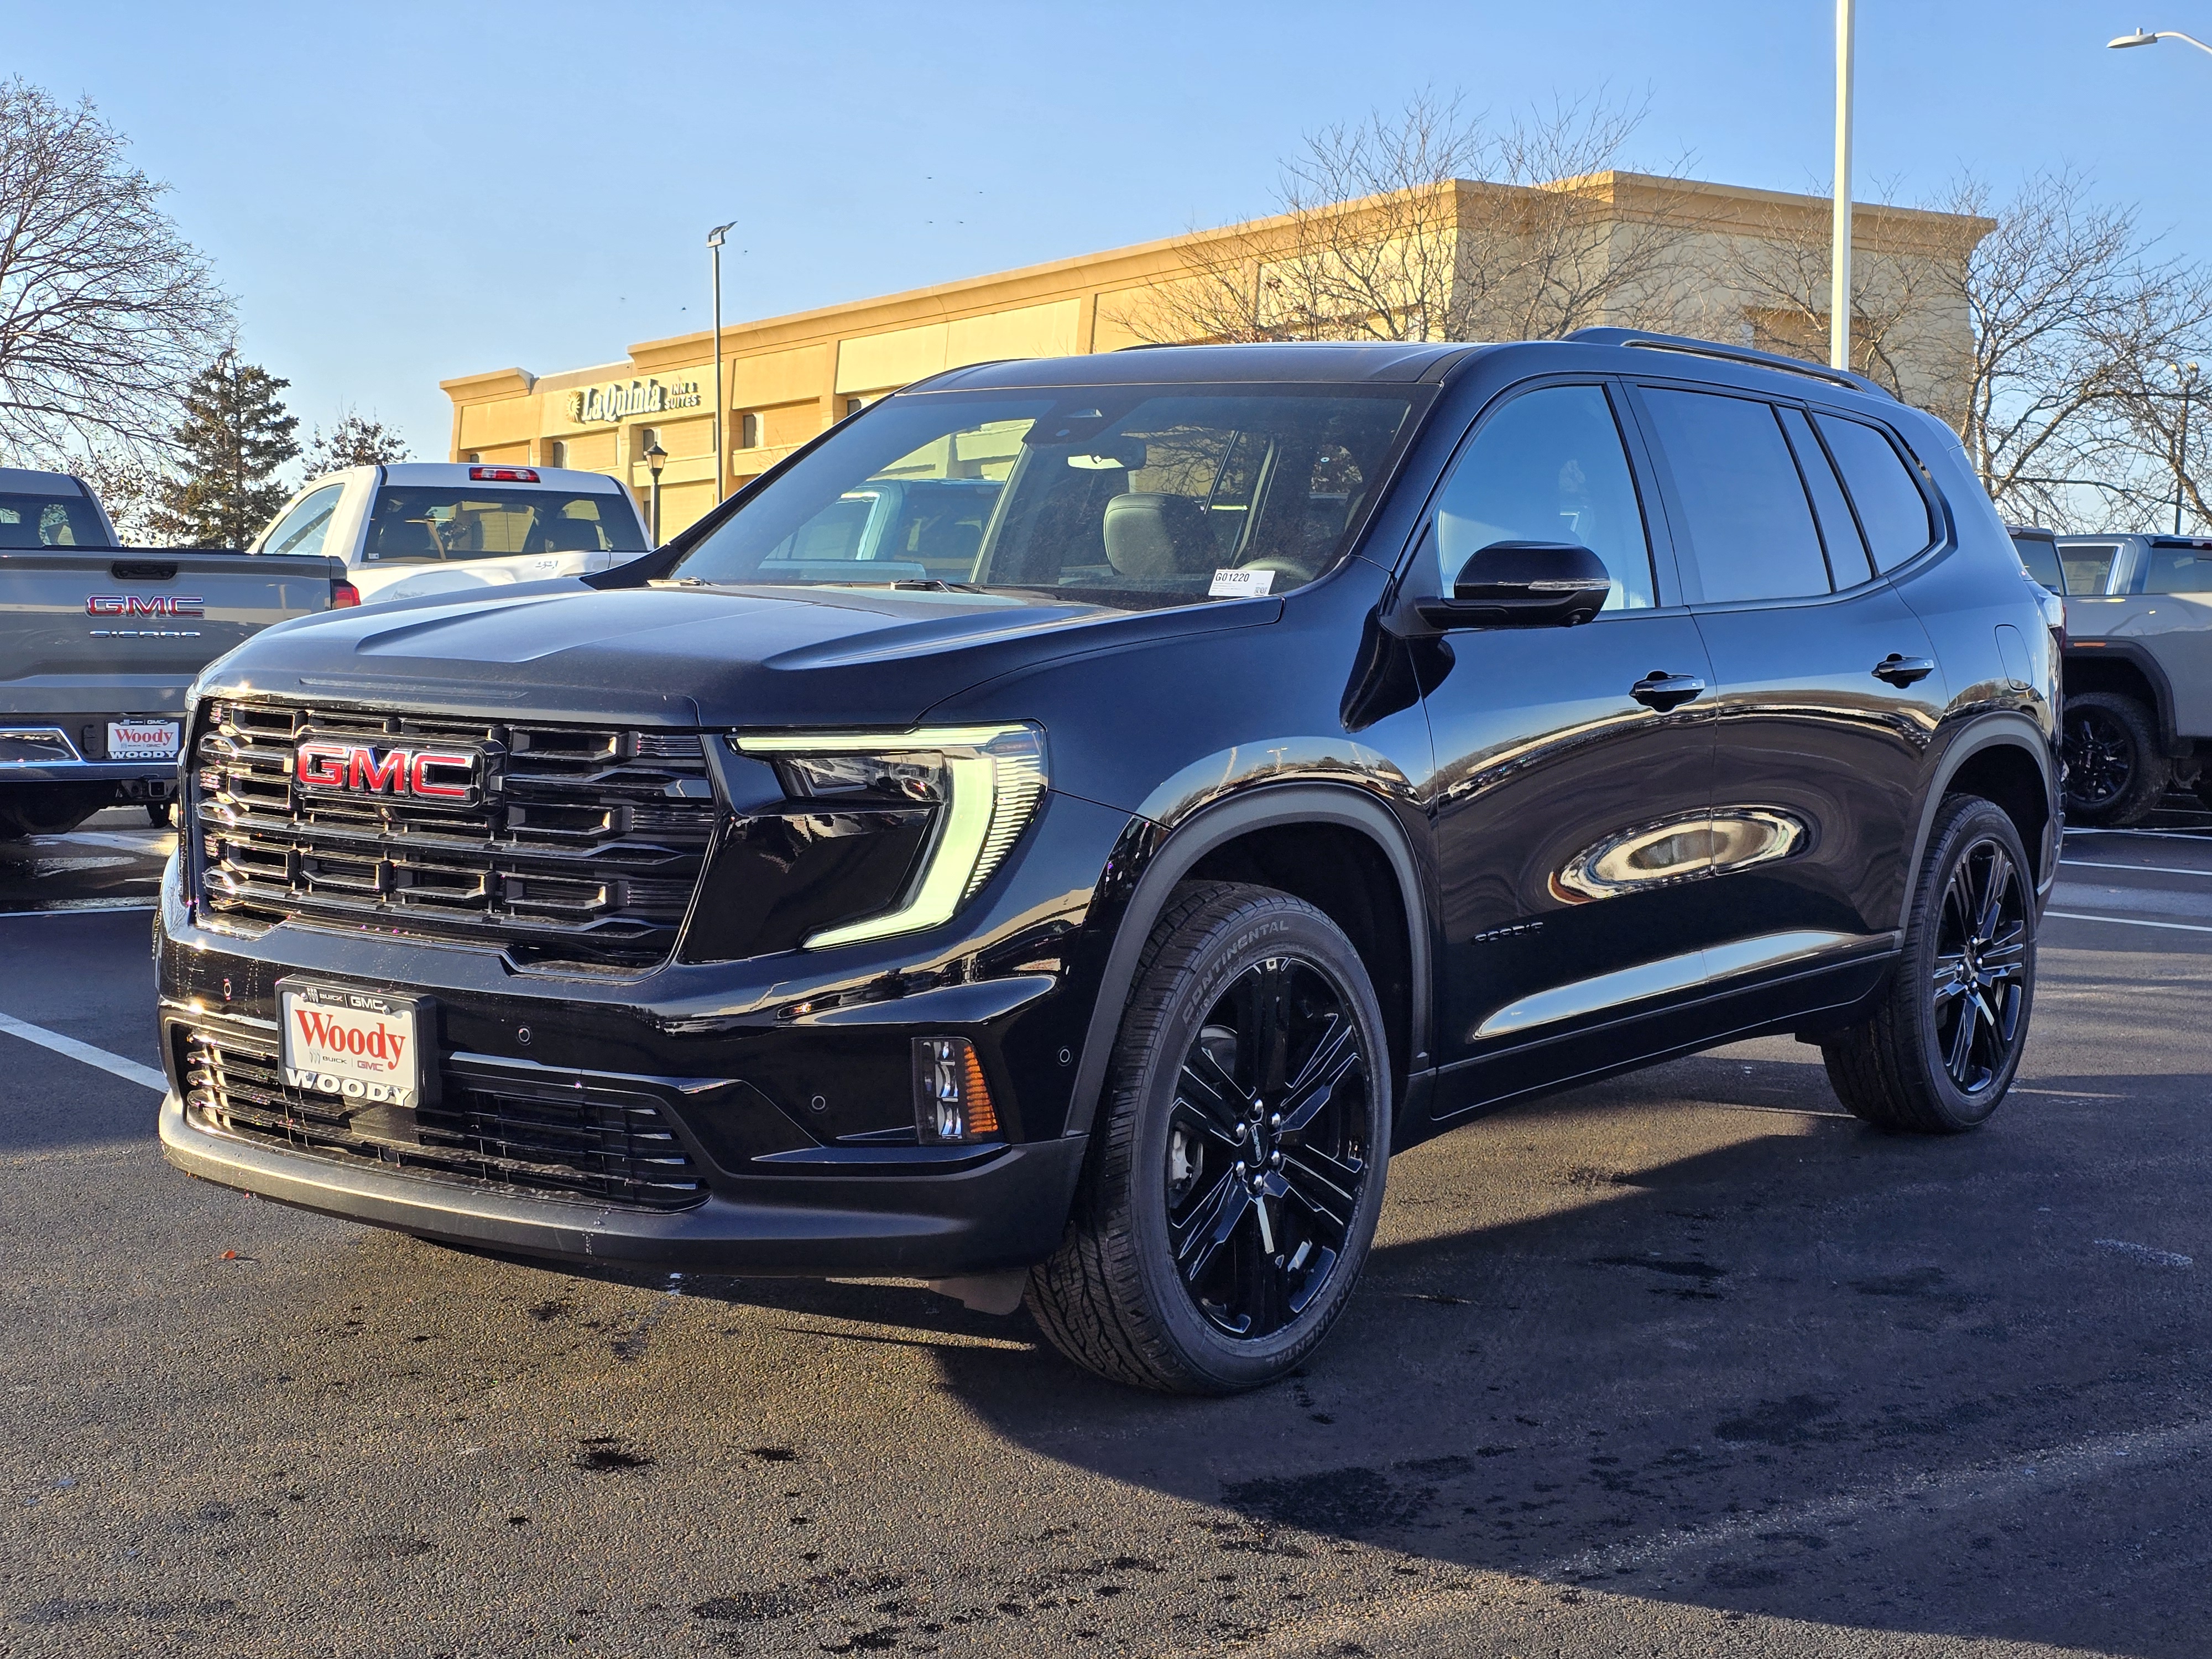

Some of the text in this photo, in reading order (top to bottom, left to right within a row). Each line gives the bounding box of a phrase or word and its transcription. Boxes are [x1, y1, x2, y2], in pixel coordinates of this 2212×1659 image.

[670, 383, 686, 395] INN
[664, 394, 698, 410] SUITES
[1215, 573, 1250, 582] G01220
[86, 595, 204, 618] GMC
[89, 630, 201, 639] SIERRA
[114, 728, 174, 745] Woody
[109, 751, 178, 759] WOODY
[298, 743, 476, 801] GMC
[1182, 920, 1289, 1024] CONTINENTAL
[319, 993, 384, 1010] BUICK GMC
[295, 1009, 406, 1071] Woody
[322, 1056, 384, 1072] BUICK GMC
[285, 1067, 413, 1107] WOODY
